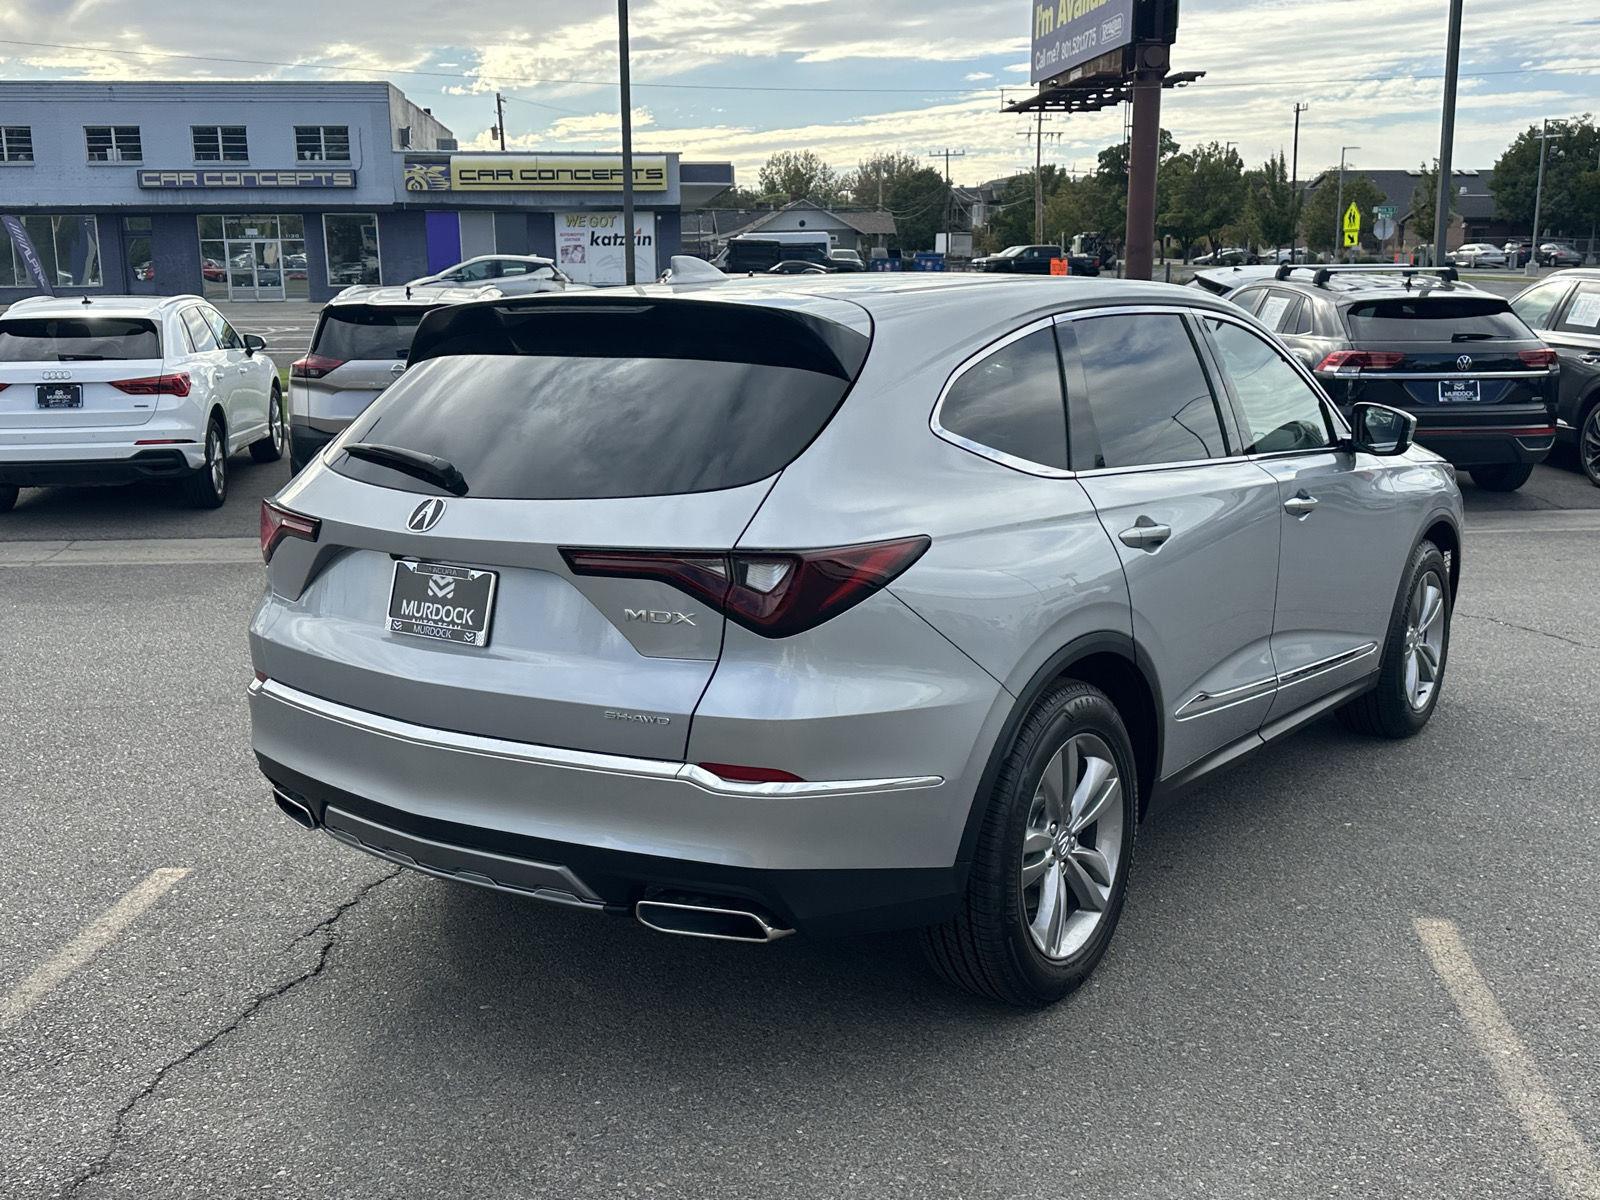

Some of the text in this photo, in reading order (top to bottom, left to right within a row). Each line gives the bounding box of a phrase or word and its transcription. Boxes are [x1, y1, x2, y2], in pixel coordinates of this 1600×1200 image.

[1035, 4, 1054, 40] I'm
[141, 172, 352, 186] CAR CONCEPTS
[459, 169, 514, 181] CAR
[565, 214, 617, 228] WE GOT
[589, 230, 652, 247] katzin
[401, 599, 474, 625] MURDOCK
[624, 608, 697, 627] MDX
[413, 624, 452, 639] MURDOCK
[603, 710, 671, 726] SH-AWD
